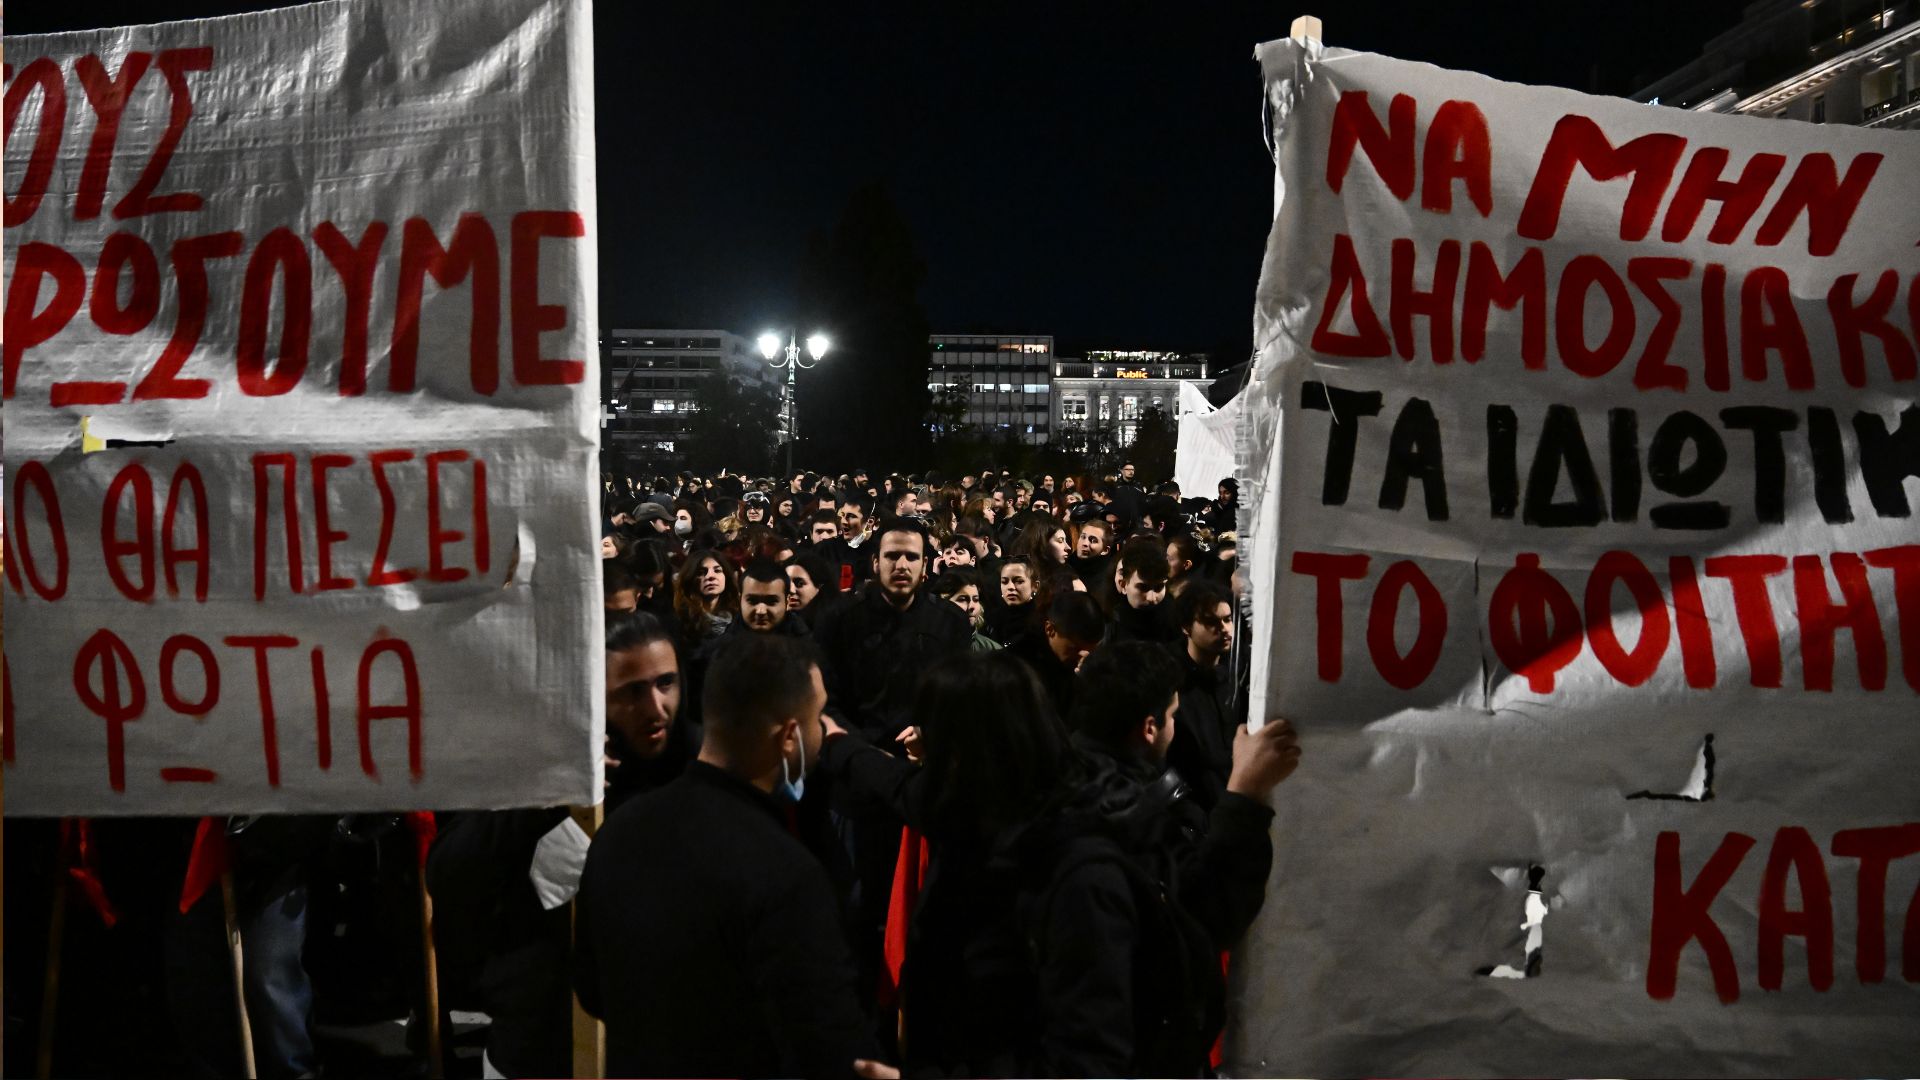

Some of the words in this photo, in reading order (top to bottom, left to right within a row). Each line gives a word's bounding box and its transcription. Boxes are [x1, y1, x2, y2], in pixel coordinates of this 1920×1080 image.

[1326, 90, 1492, 218] ΝΑ
[1516, 113, 1884, 257] ΜΗΝ
[1116, 370, 1148, 379] Public
[1310, 235, 1815, 392] ΔΗΜΟΣΙΑ
[1300, 382, 1449, 521] ΤΑ
[101, 459, 210, 602] ΘΑ
[252, 450, 489, 603] ΠΕΣΕΙ
[1291, 552, 1448, 690] ΤΟ
